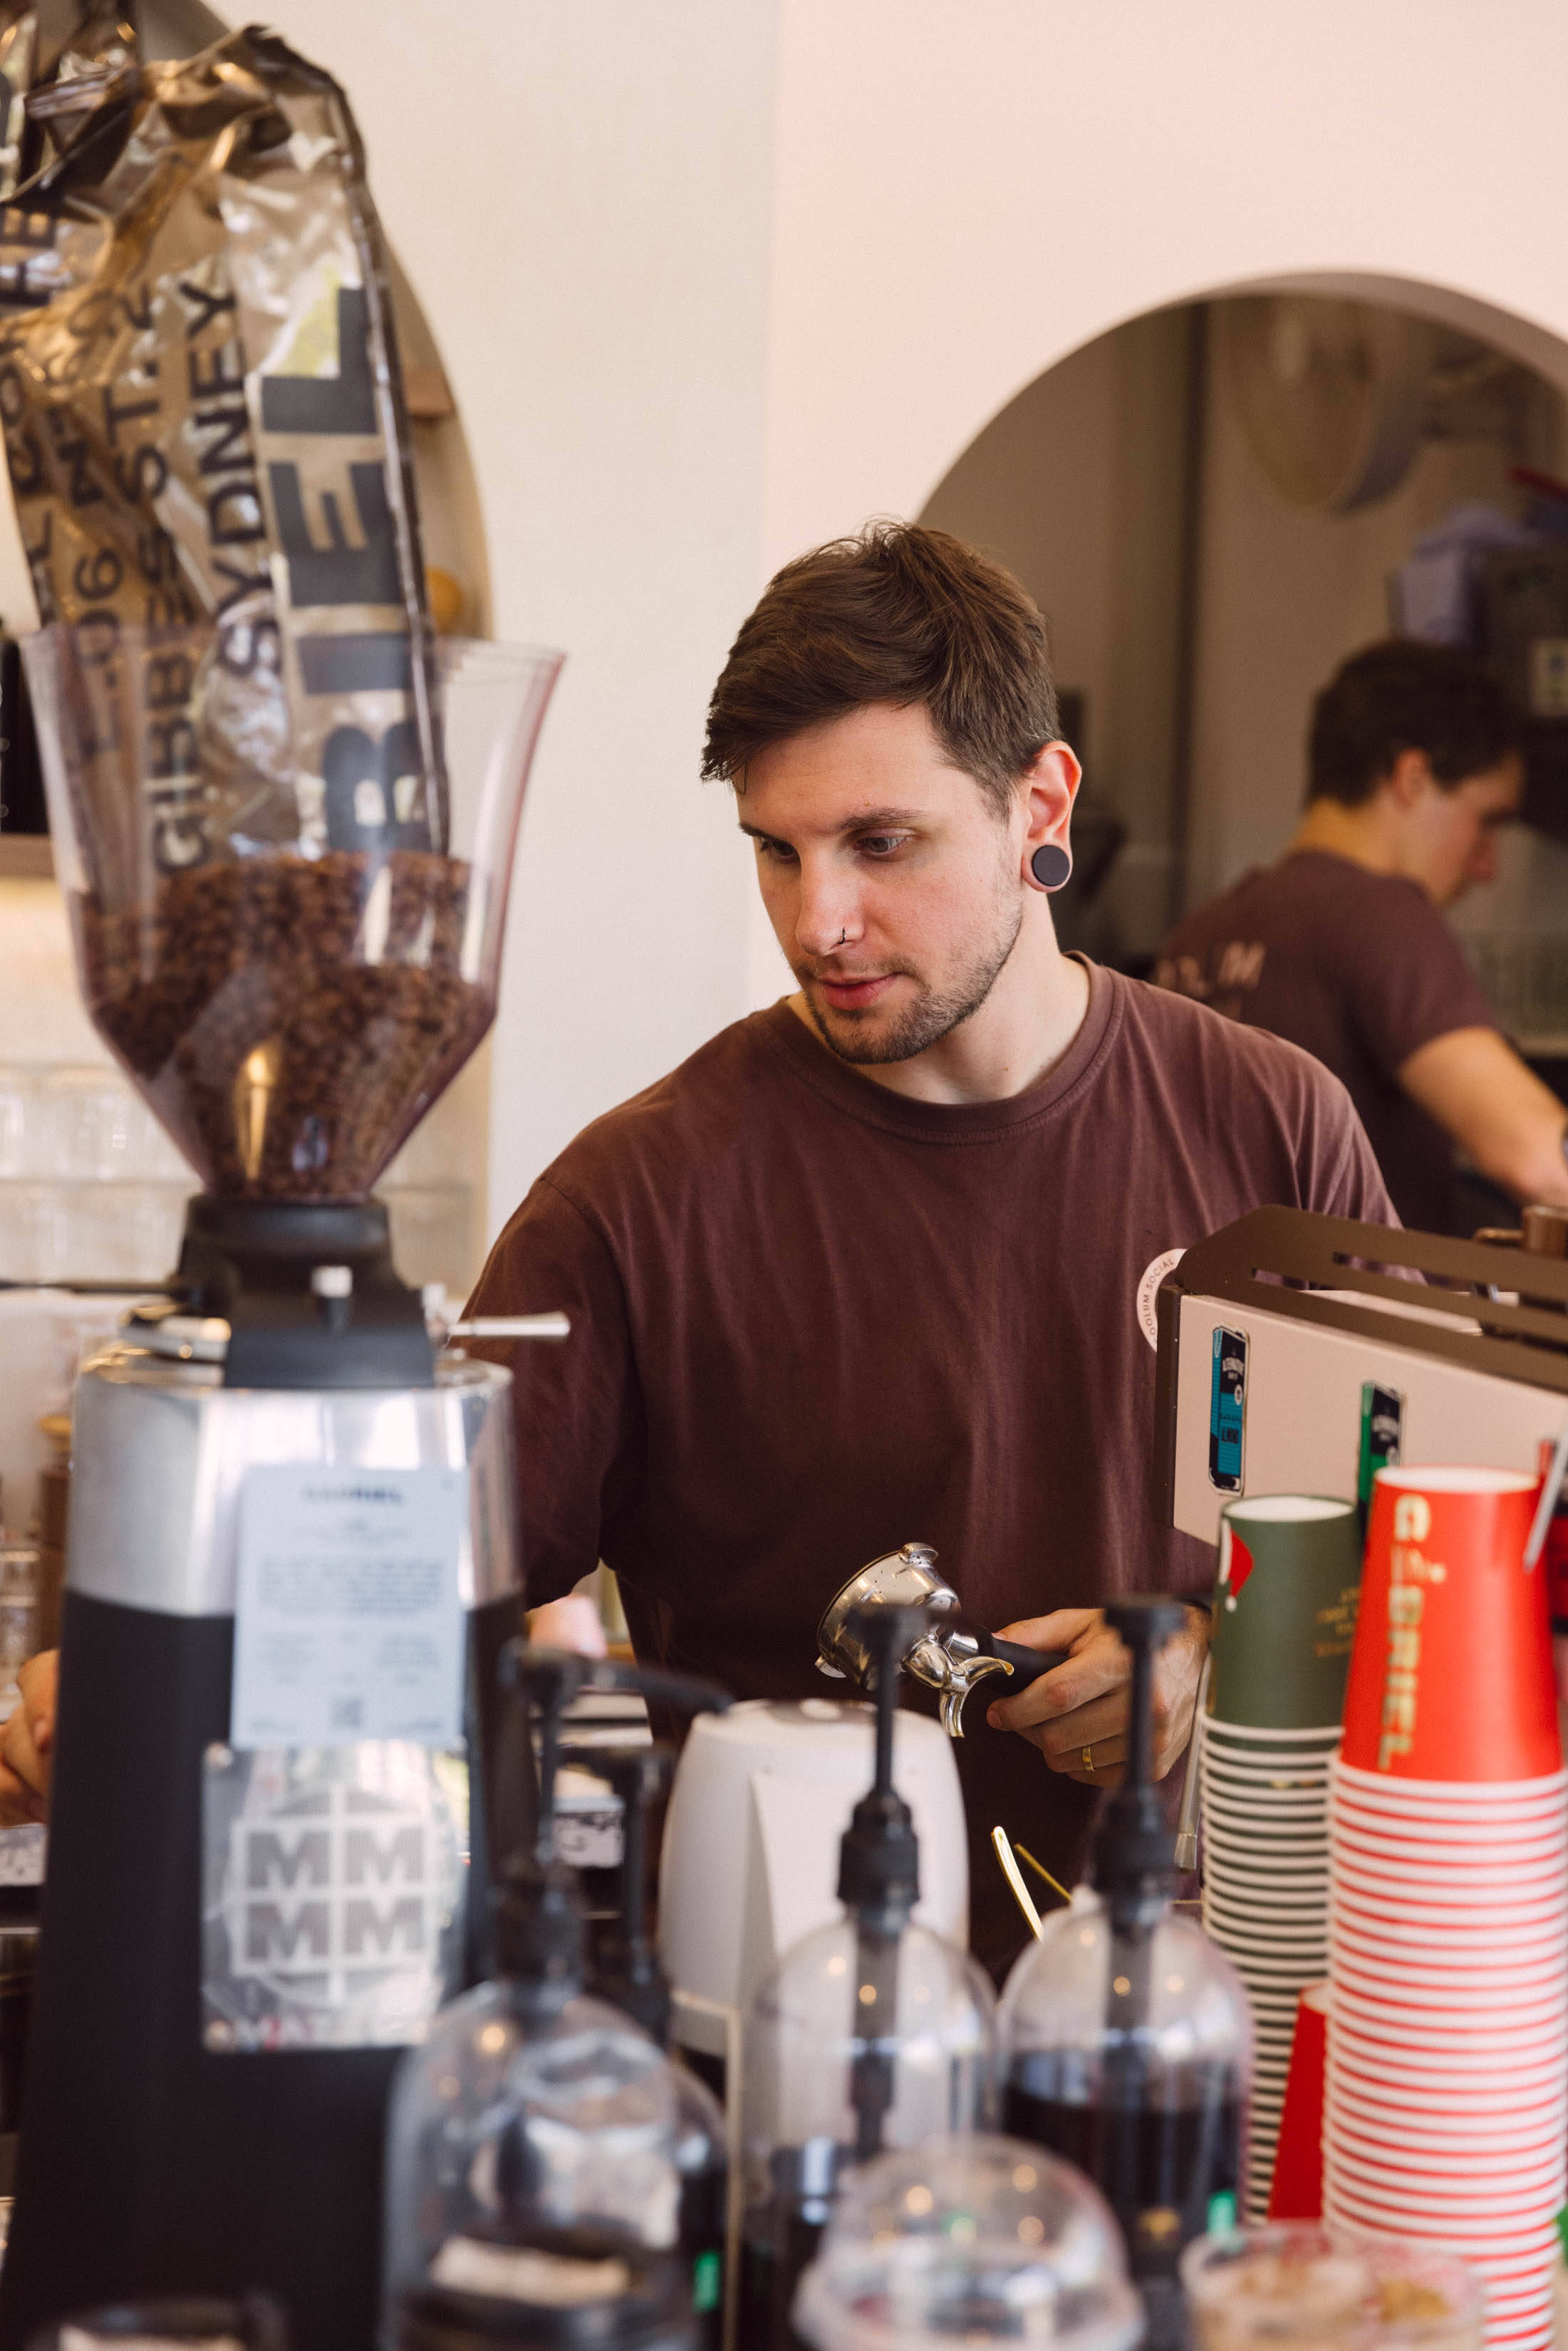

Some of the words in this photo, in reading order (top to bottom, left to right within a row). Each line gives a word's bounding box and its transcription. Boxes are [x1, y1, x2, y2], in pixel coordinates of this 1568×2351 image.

[102, 362, 167, 504] ST.
[178, 281, 281, 675] SYDNEY
[1142, 1293, 1158, 1344] OOLUM
[1146, 1257, 1175, 1290] SOCIAL
